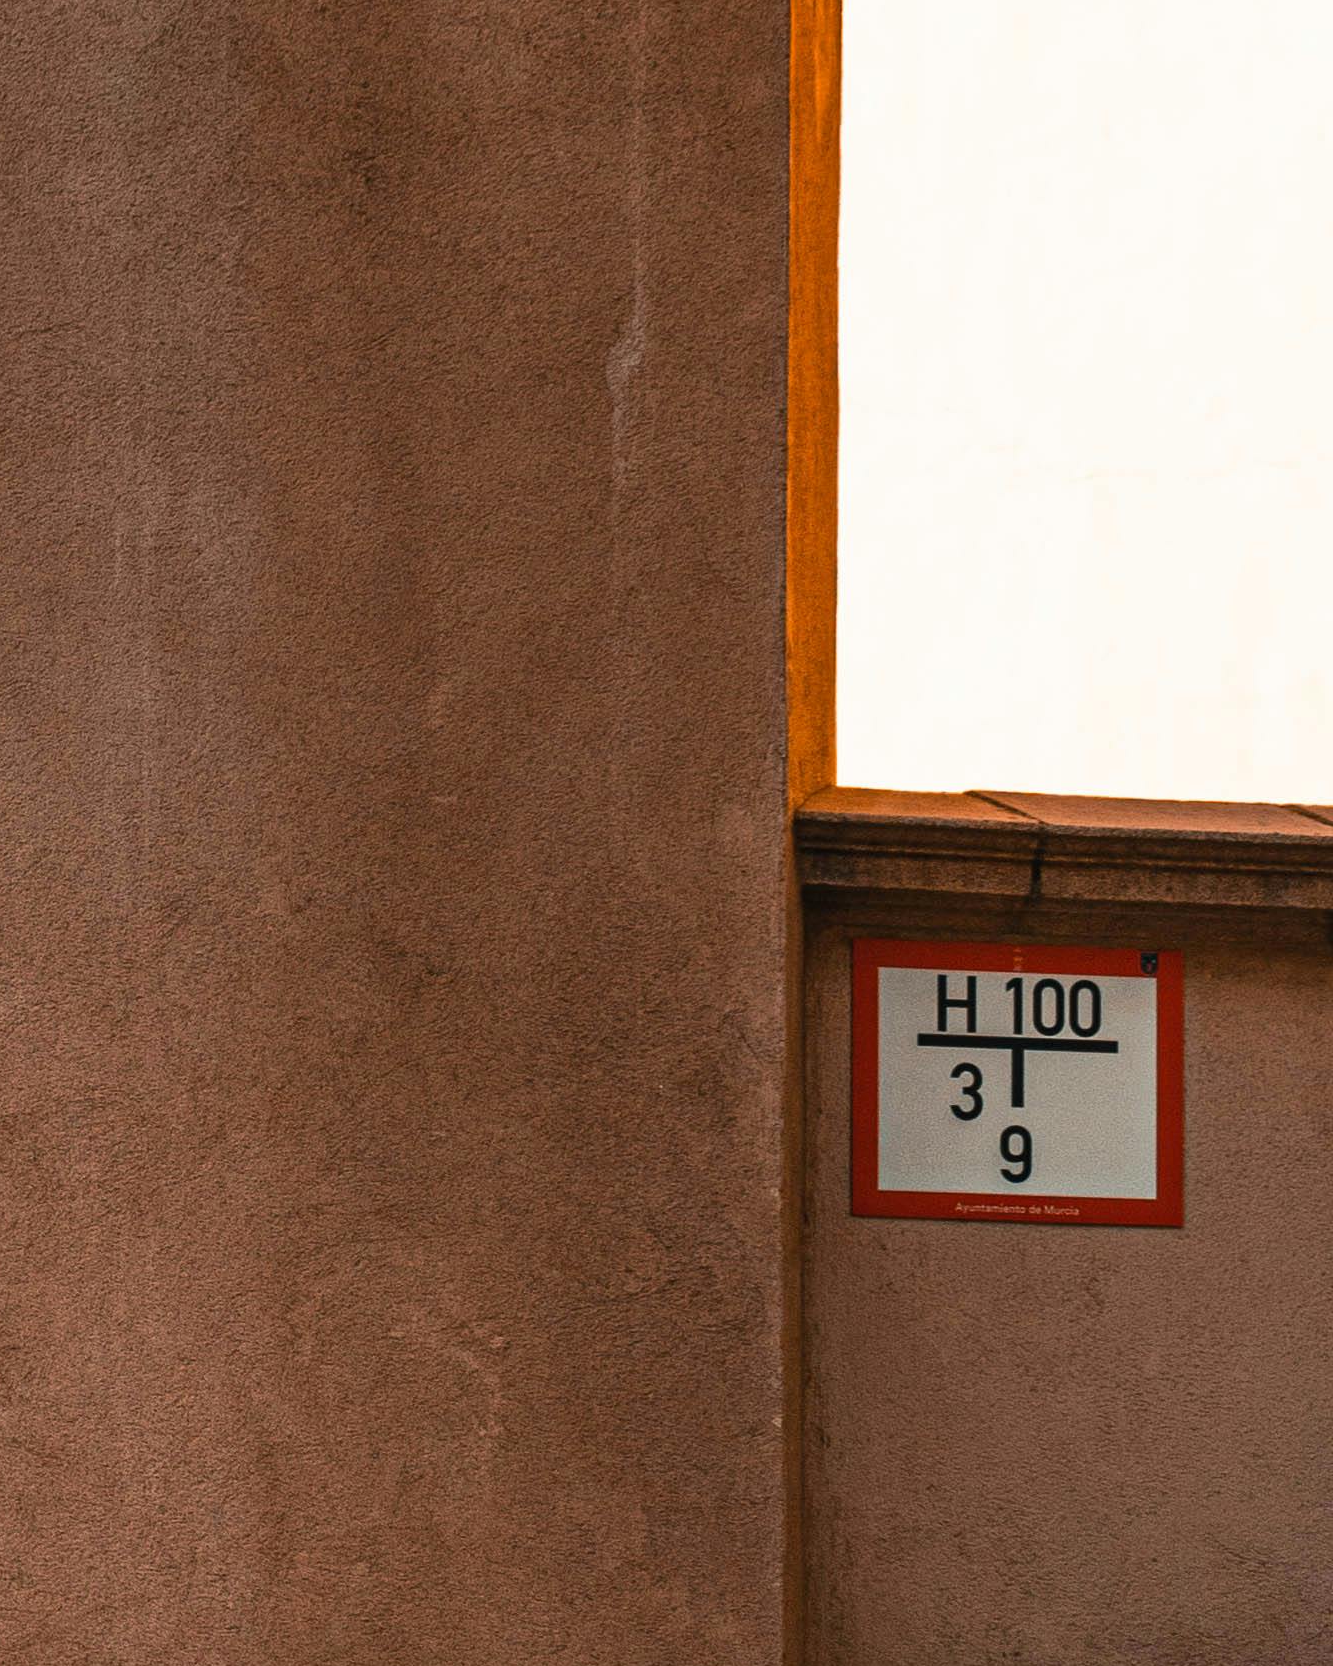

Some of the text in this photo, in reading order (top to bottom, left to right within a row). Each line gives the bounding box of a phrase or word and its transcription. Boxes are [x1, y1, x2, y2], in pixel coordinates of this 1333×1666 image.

[937, 974, 1102, 1038] H 100
[950, 1062, 984, 1121] 3
[999, 1125, 1033, 1184] 9
[955, 1202, 1026, 1214] Ayuntamiento
[1044, 1205, 1080, 1215] Murcia
